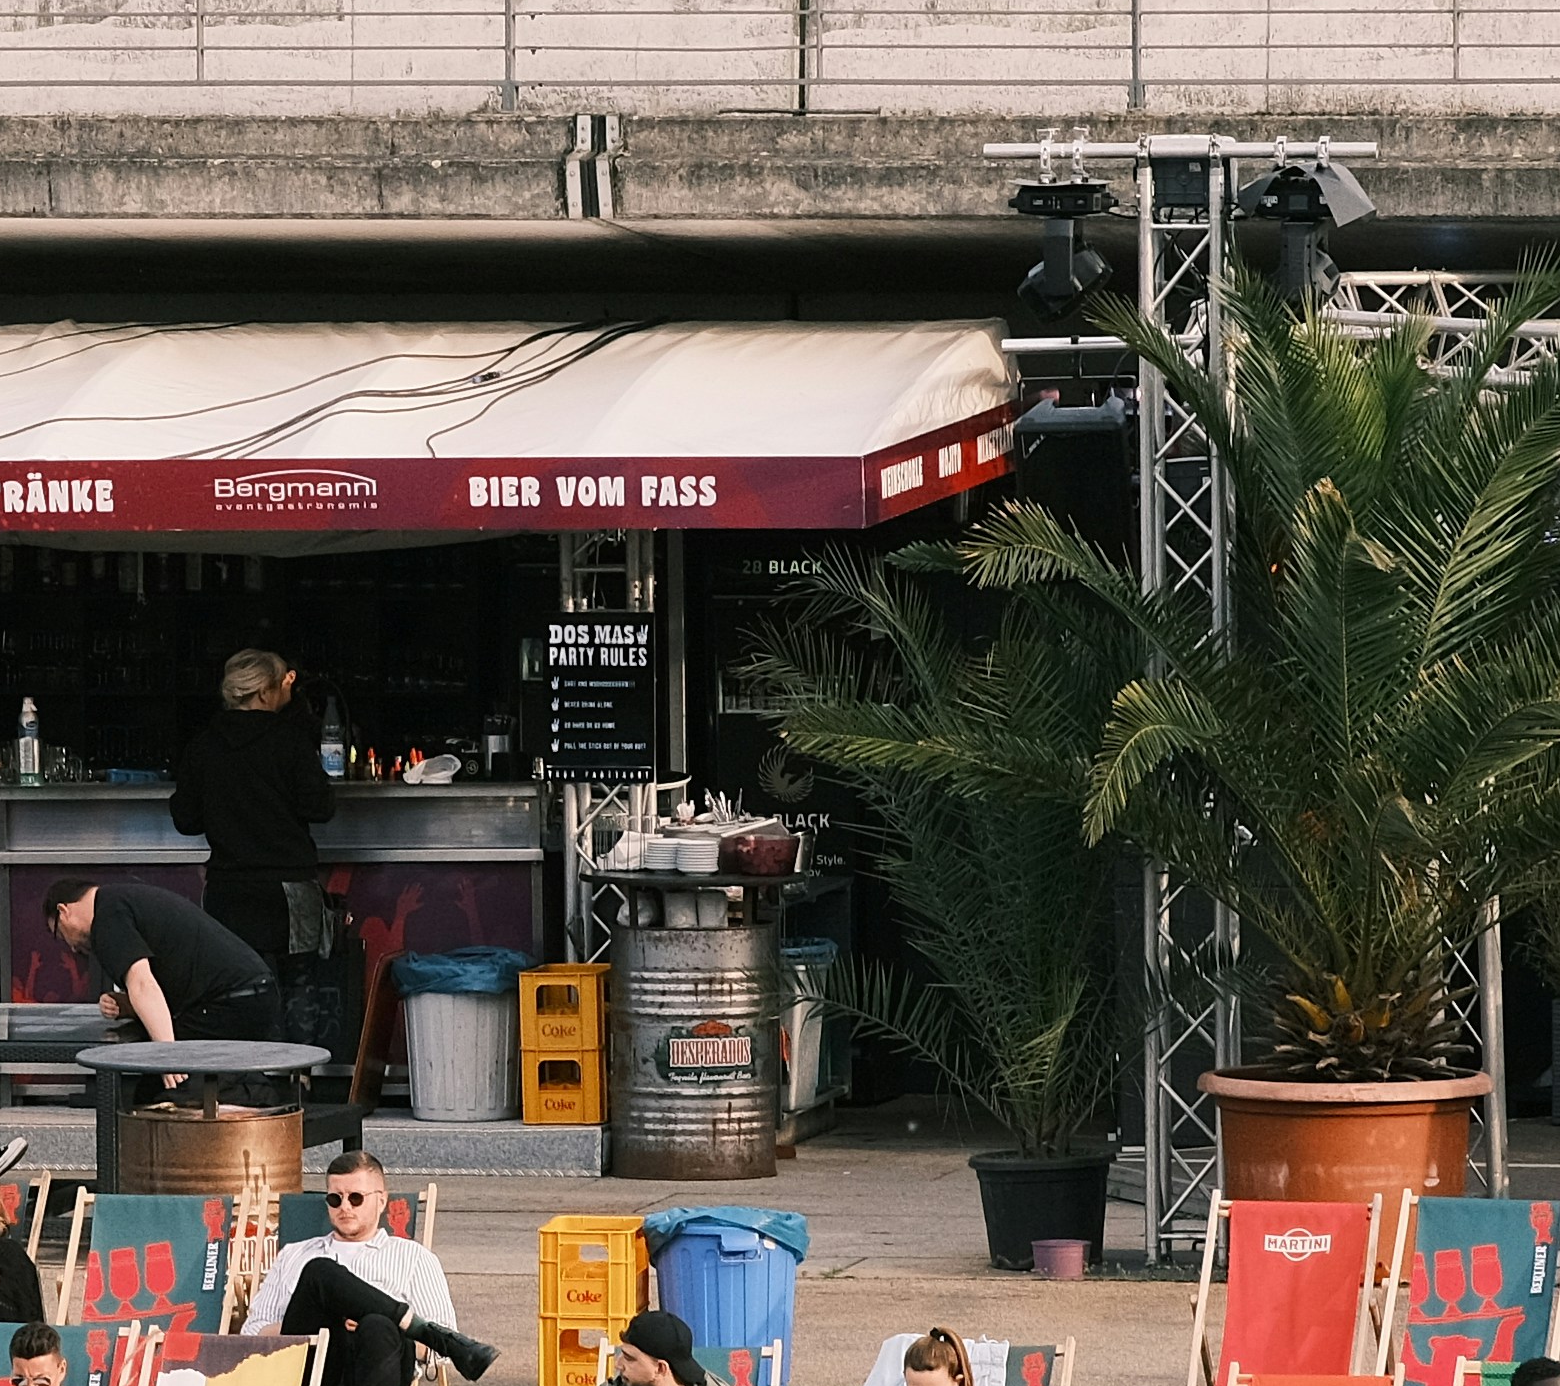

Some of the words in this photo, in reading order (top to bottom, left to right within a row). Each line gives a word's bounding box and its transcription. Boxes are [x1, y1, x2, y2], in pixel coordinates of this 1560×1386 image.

[214, 478, 377, 502] Bergmann
[468, 476, 540, 508] BIER
[556, 476, 625, 507] VOM
[640, 476, 717, 507] FASS
[548, 624, 591, 644] DOS
[594, 624, 636, 644] MAS
[549, 646, 596, 666] PARTY
[600, 646, 648, 666] RULES
[541, 1024, 577, 1038] Coke
[670, 1037, 751, 1066] DESPERADOS
[543, 1098, 577, 1111] Coke
[1267, 1237, 1329, 1251] MARTINI
[202, 1242, 219, 1291] BERLINER
[1530, 1245, 1547, 1293] BERLINER
[566, 1290, 603, 1304] Coke
